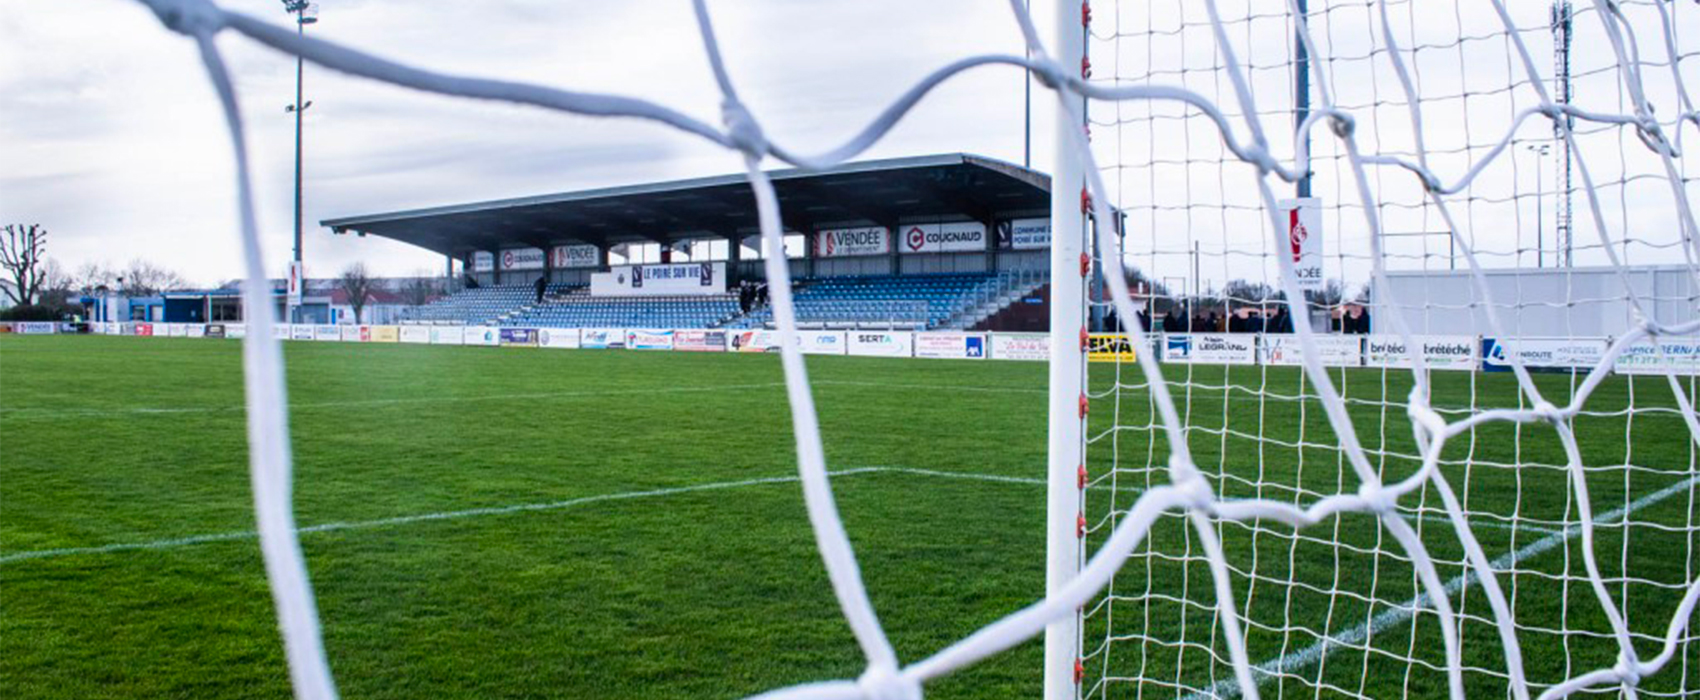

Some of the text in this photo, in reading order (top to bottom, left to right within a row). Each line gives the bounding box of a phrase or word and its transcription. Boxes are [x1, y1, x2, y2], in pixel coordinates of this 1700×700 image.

[836, 229, 880, 246] VENDÉE
[925, 231, 982, 243] COUGNAUD
[644, 266, 699, 279] LE POIRÉ SUR VIE
[1294, 266, 1322, 279] NDÉE
[858, 334, 892, 343] SERTA
[1371, 341, 1406, 355] brtéc
[1516, 351, 1553, 360] NROUTE
